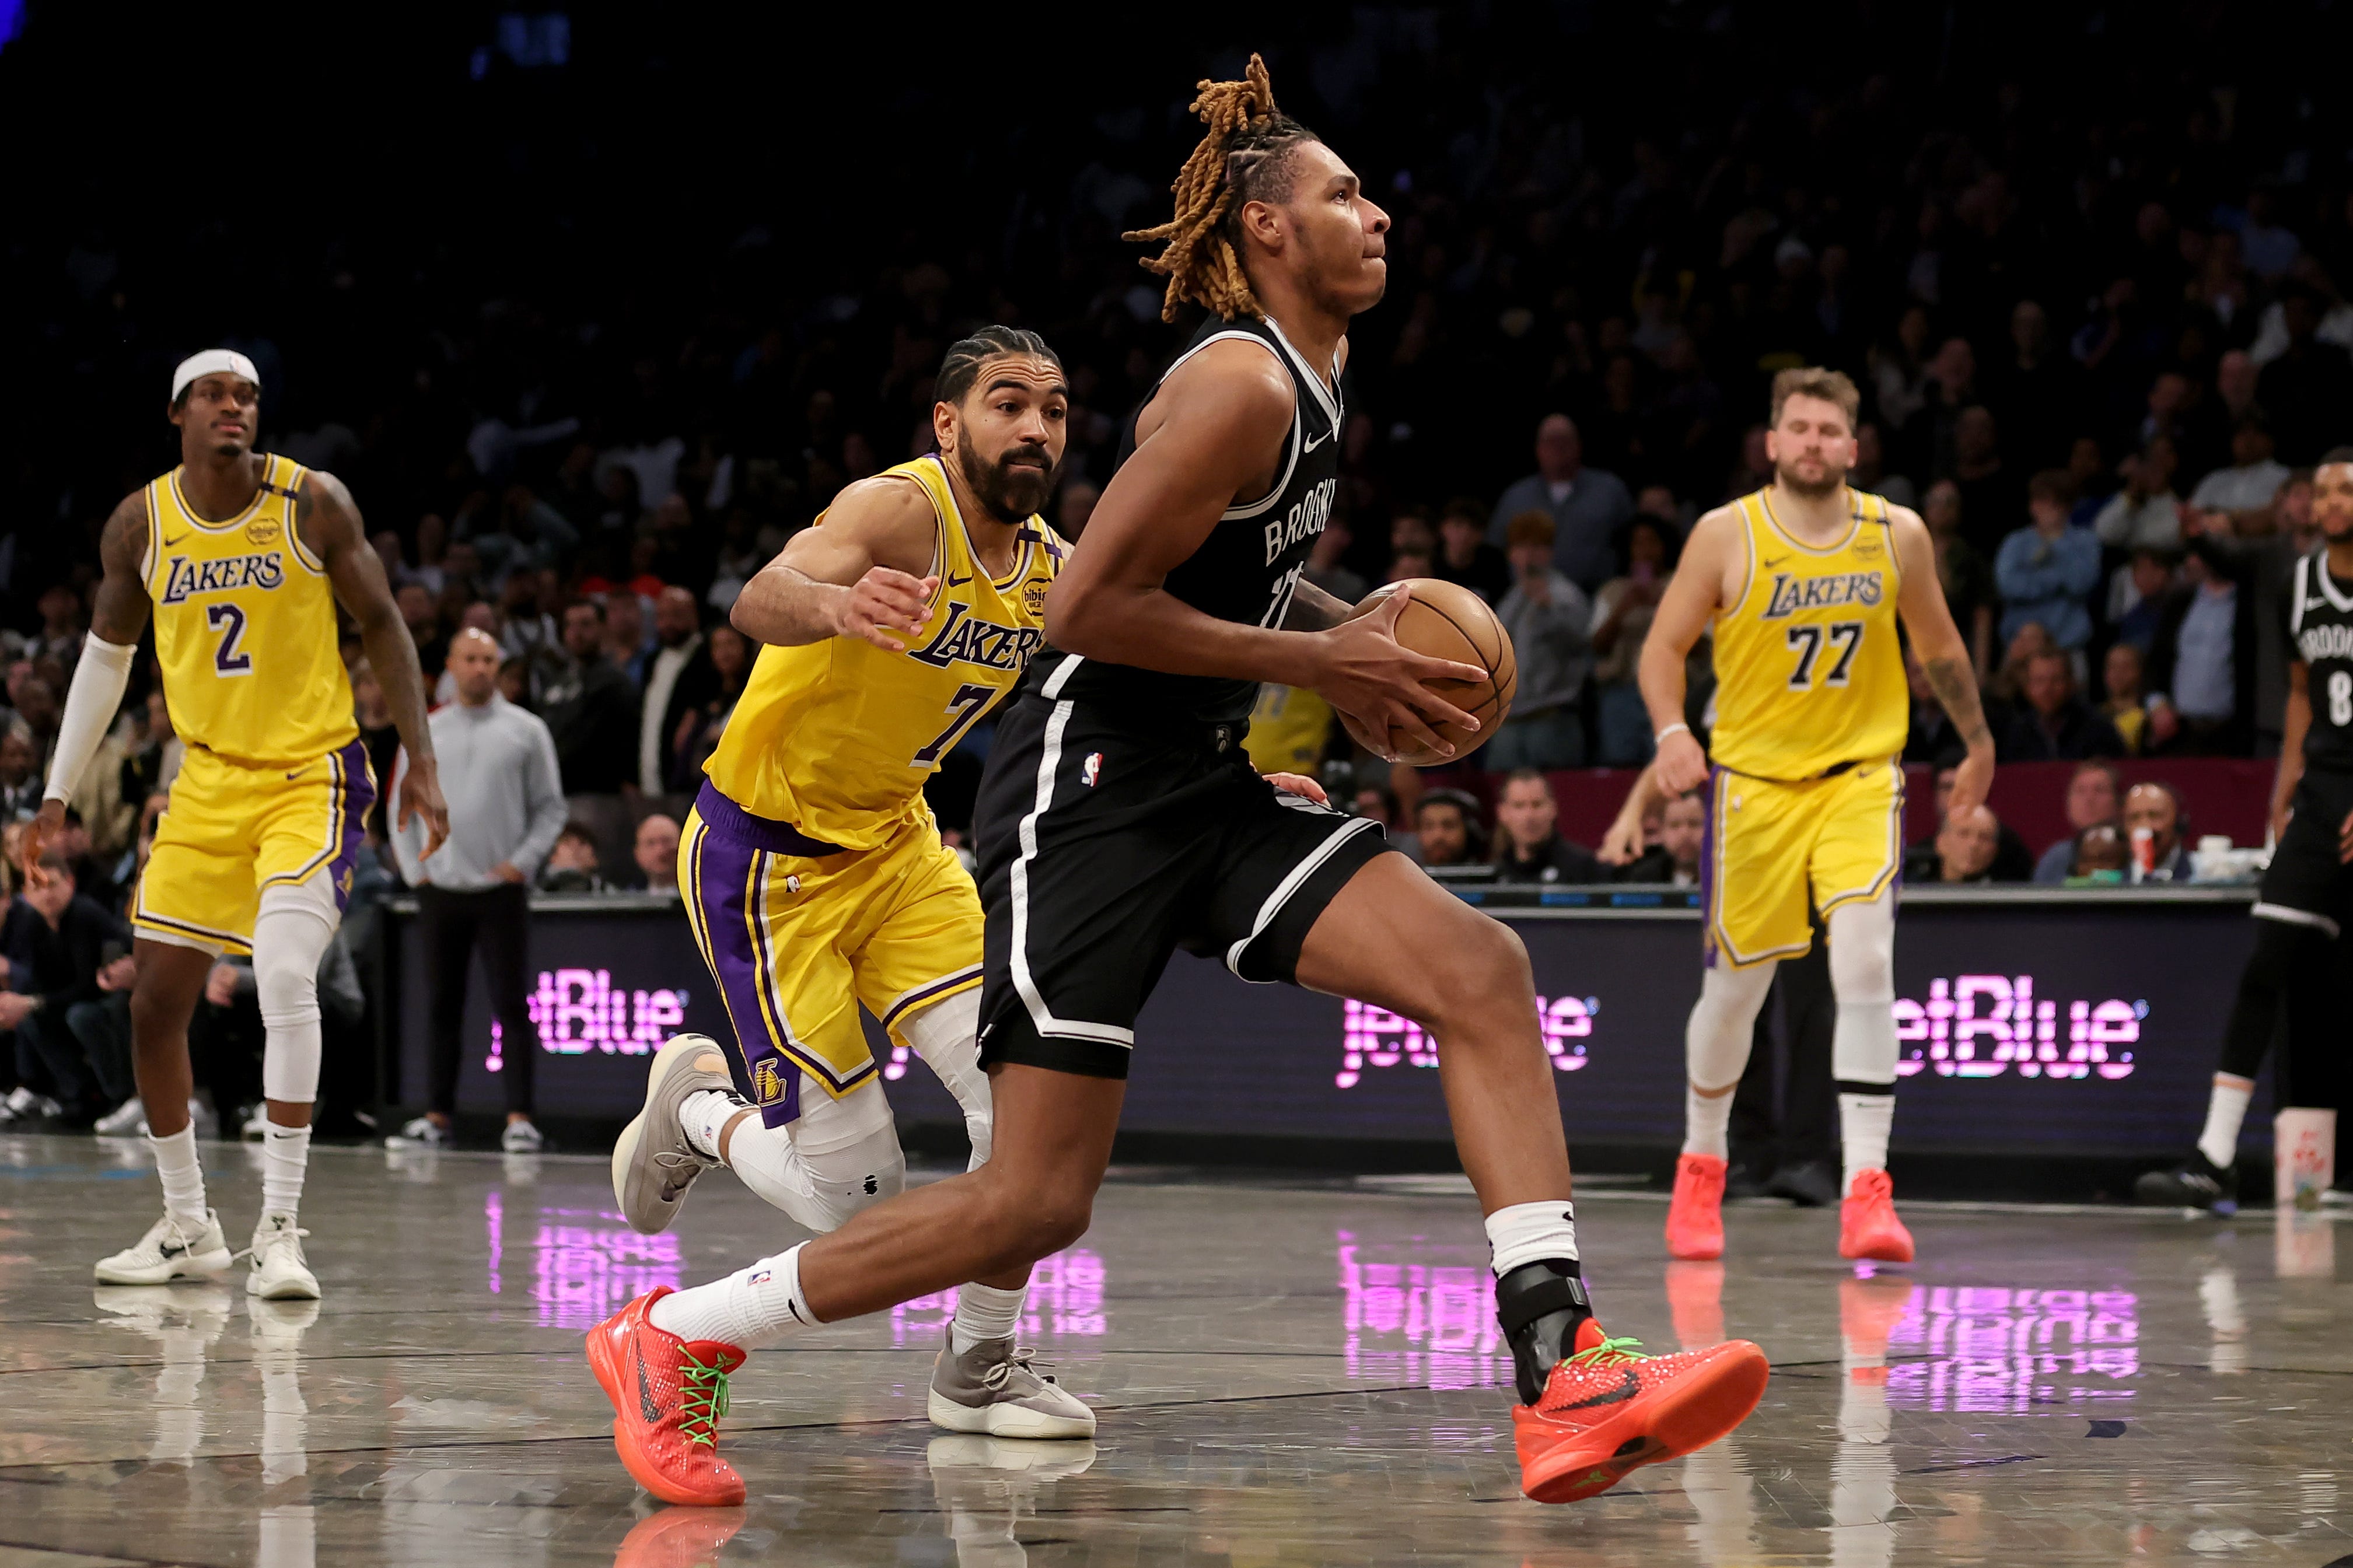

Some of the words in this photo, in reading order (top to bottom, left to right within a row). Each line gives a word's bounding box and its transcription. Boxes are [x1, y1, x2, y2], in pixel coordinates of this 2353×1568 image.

[160, 552, 285, 606] LAKERS
[1760, 571, 1884, 620] LAKERS
[207, 604, 253, 677] 2
[1787, 621, 1865, 691] 77
[908, 683, 1000, 768] 7
[1891, 975, 2141, 1080] etBlue
